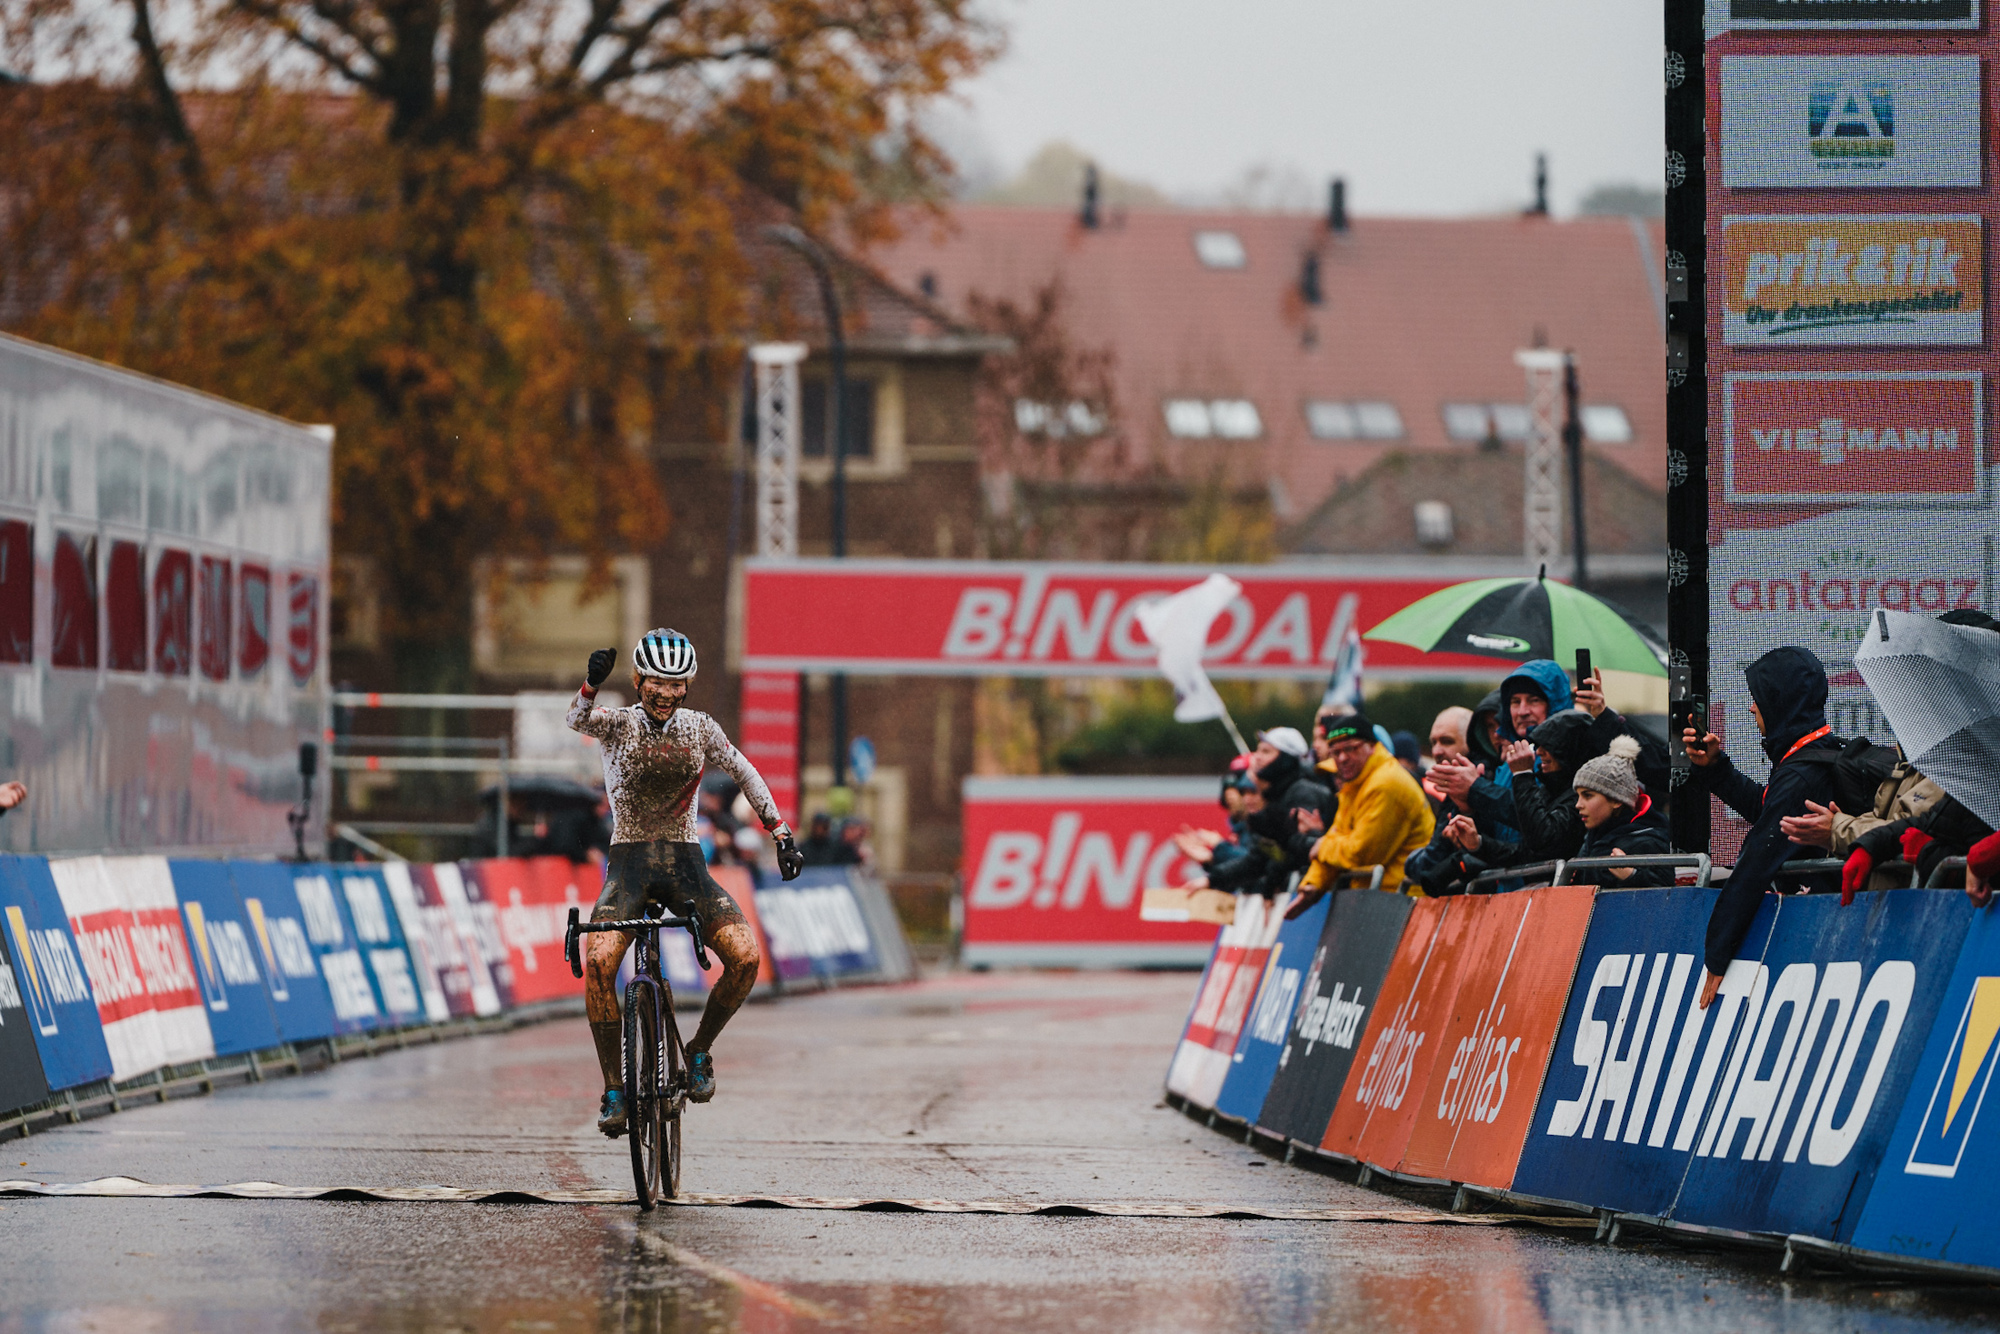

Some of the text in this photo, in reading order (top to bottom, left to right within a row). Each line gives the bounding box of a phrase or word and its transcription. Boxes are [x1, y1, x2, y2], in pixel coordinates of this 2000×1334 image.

[1743, 237, 1961, 300] prik&tik
[29, 928, 90, 1004] VARTA
[1547, 953, 1916, 1167] SHIMANO
